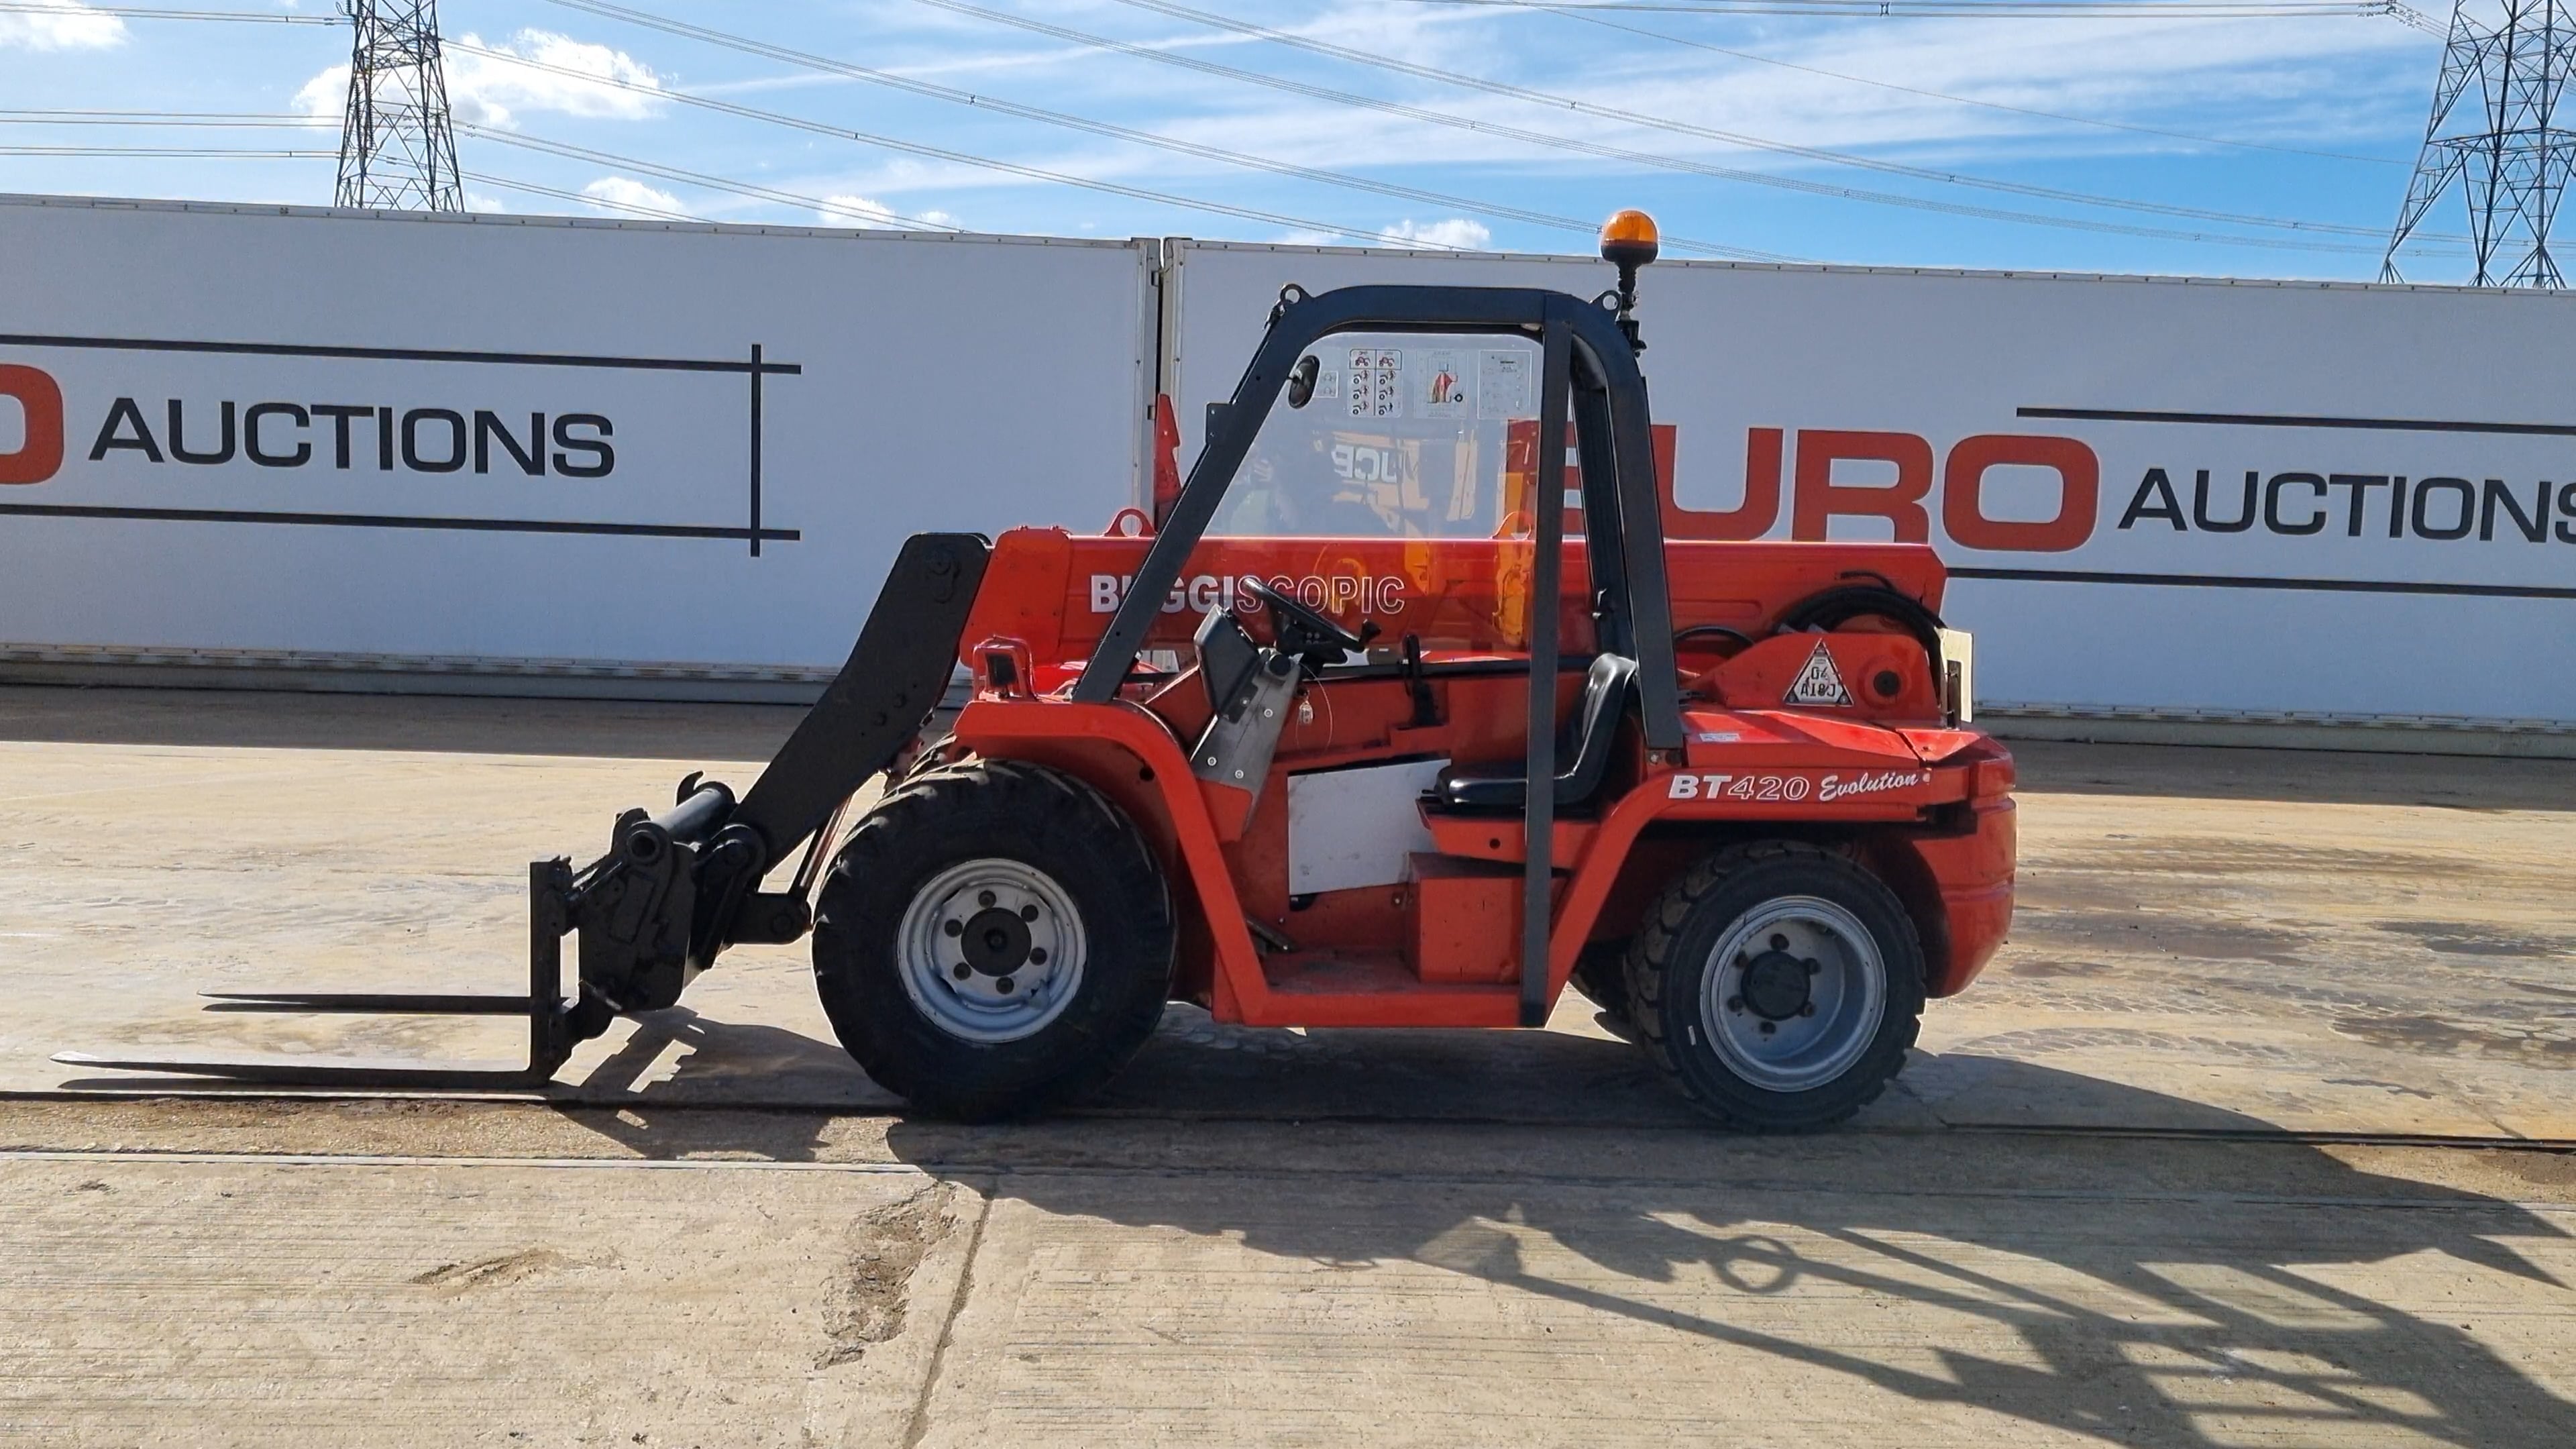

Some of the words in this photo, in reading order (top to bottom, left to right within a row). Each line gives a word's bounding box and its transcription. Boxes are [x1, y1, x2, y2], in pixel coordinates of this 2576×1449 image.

[89, 397, 615, 478] AUCTIONS
[1668, 775, 1810, 800] BT420
[1819, 772, 1919, 802] Evolution
